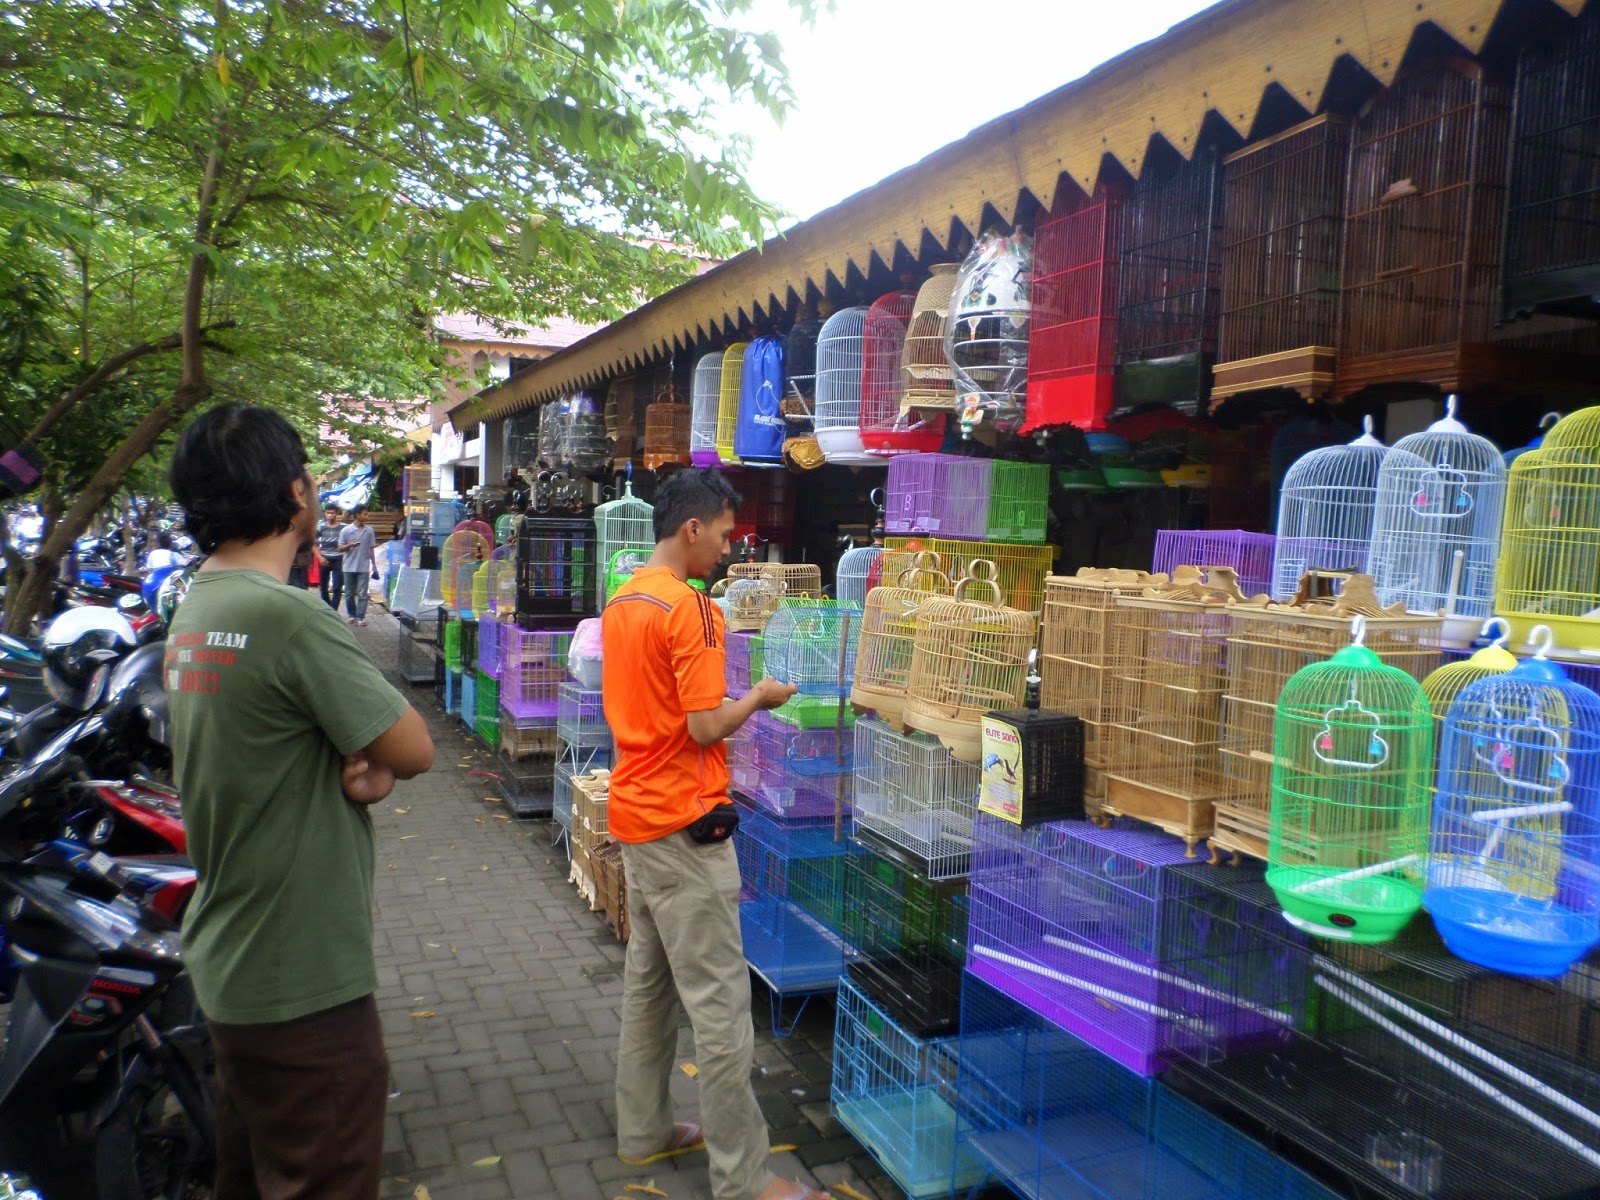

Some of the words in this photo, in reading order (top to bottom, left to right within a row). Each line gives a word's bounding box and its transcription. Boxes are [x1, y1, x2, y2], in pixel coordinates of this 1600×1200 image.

[206, 631, 248, 649] TEAM
[985, 727, 1001, 739] ELITE
[91, 979, 142, 995] HONDA
